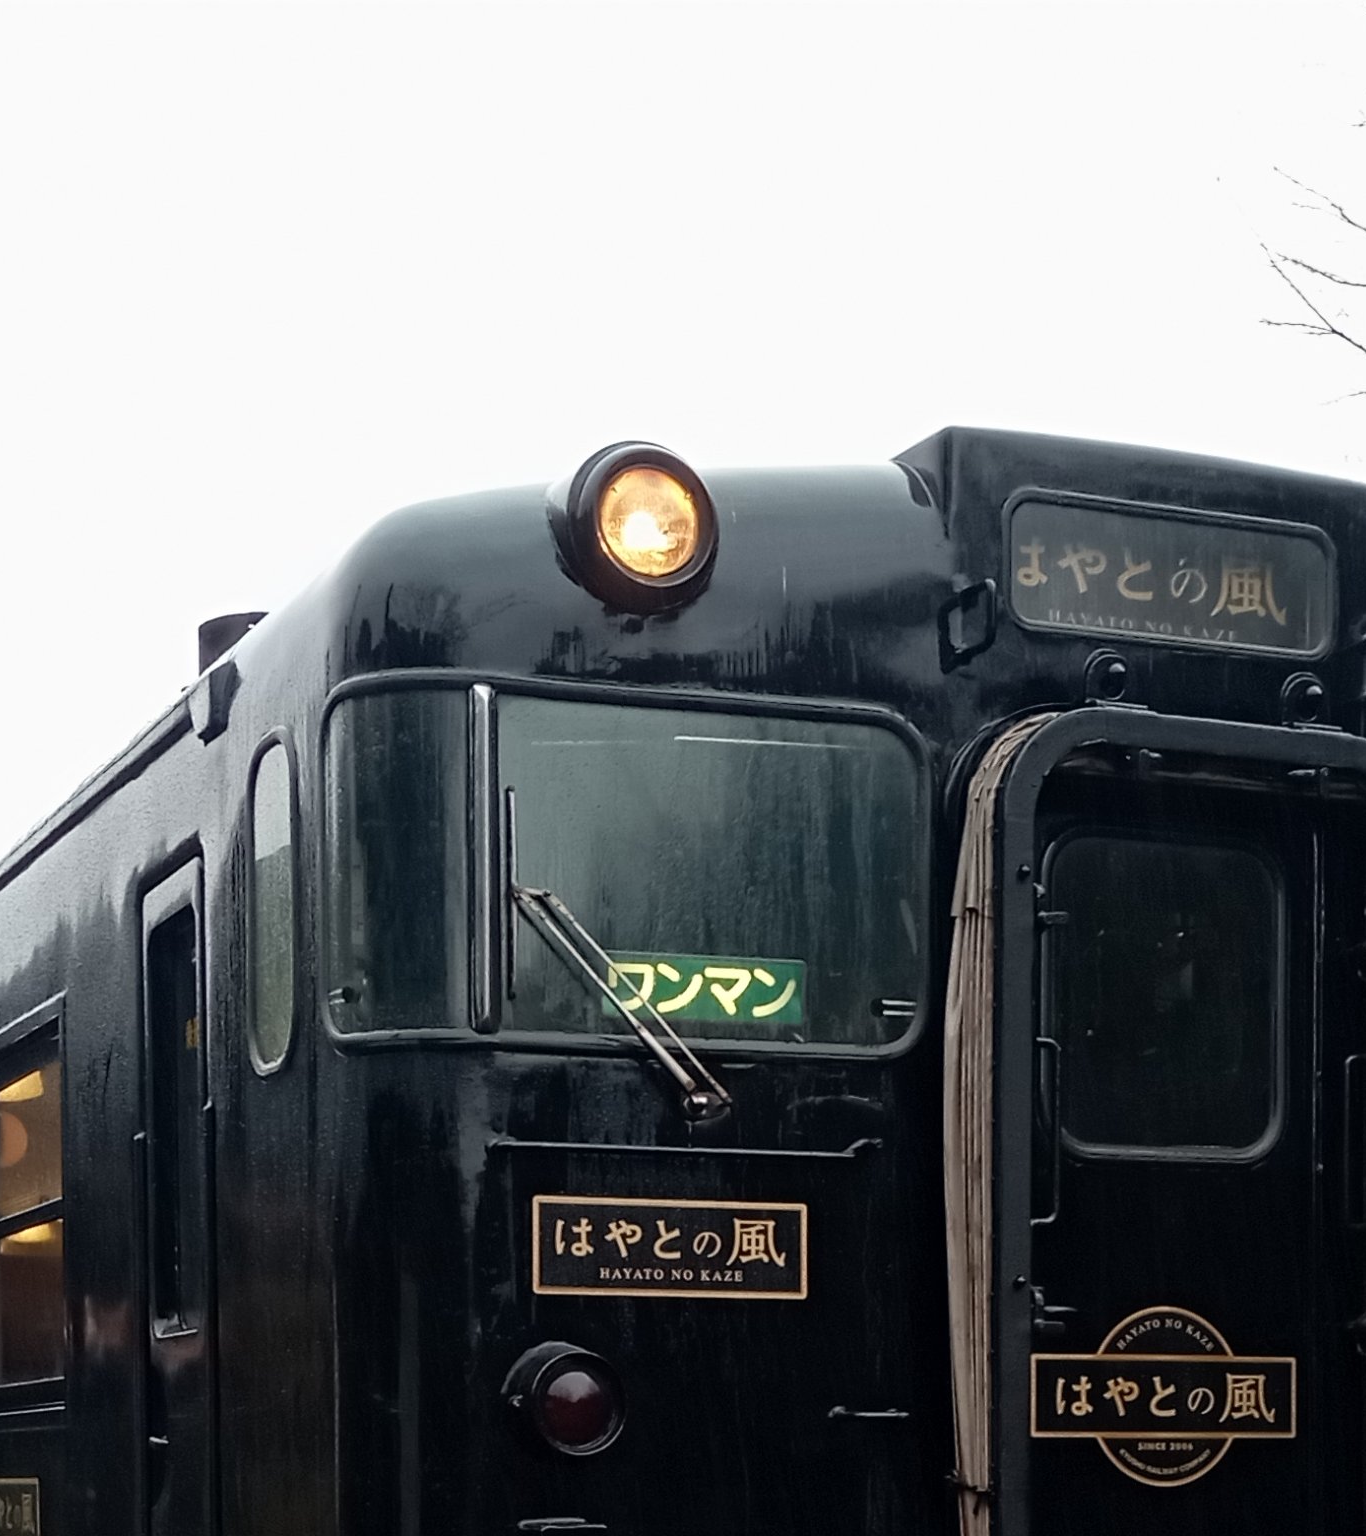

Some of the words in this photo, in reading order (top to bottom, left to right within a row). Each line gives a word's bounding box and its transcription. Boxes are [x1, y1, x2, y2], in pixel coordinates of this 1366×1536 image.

[608, 962, 796, 1018] ワンマン
[554, 1217, 786, 1267] はやとの風
[599, 1267, 665, 1282] HAYATO
[671, 1268, 694, 1282] NO
[700, 1269, 744, 1283] KAZE
[1116, 1319, 1161, 1351] HAYATO
[1165, 1319, 1183, 1330] NO
[1185, 1324, 1215, 1352] KAZE
[1055, 1372, 1276, 1423] はやとの風
